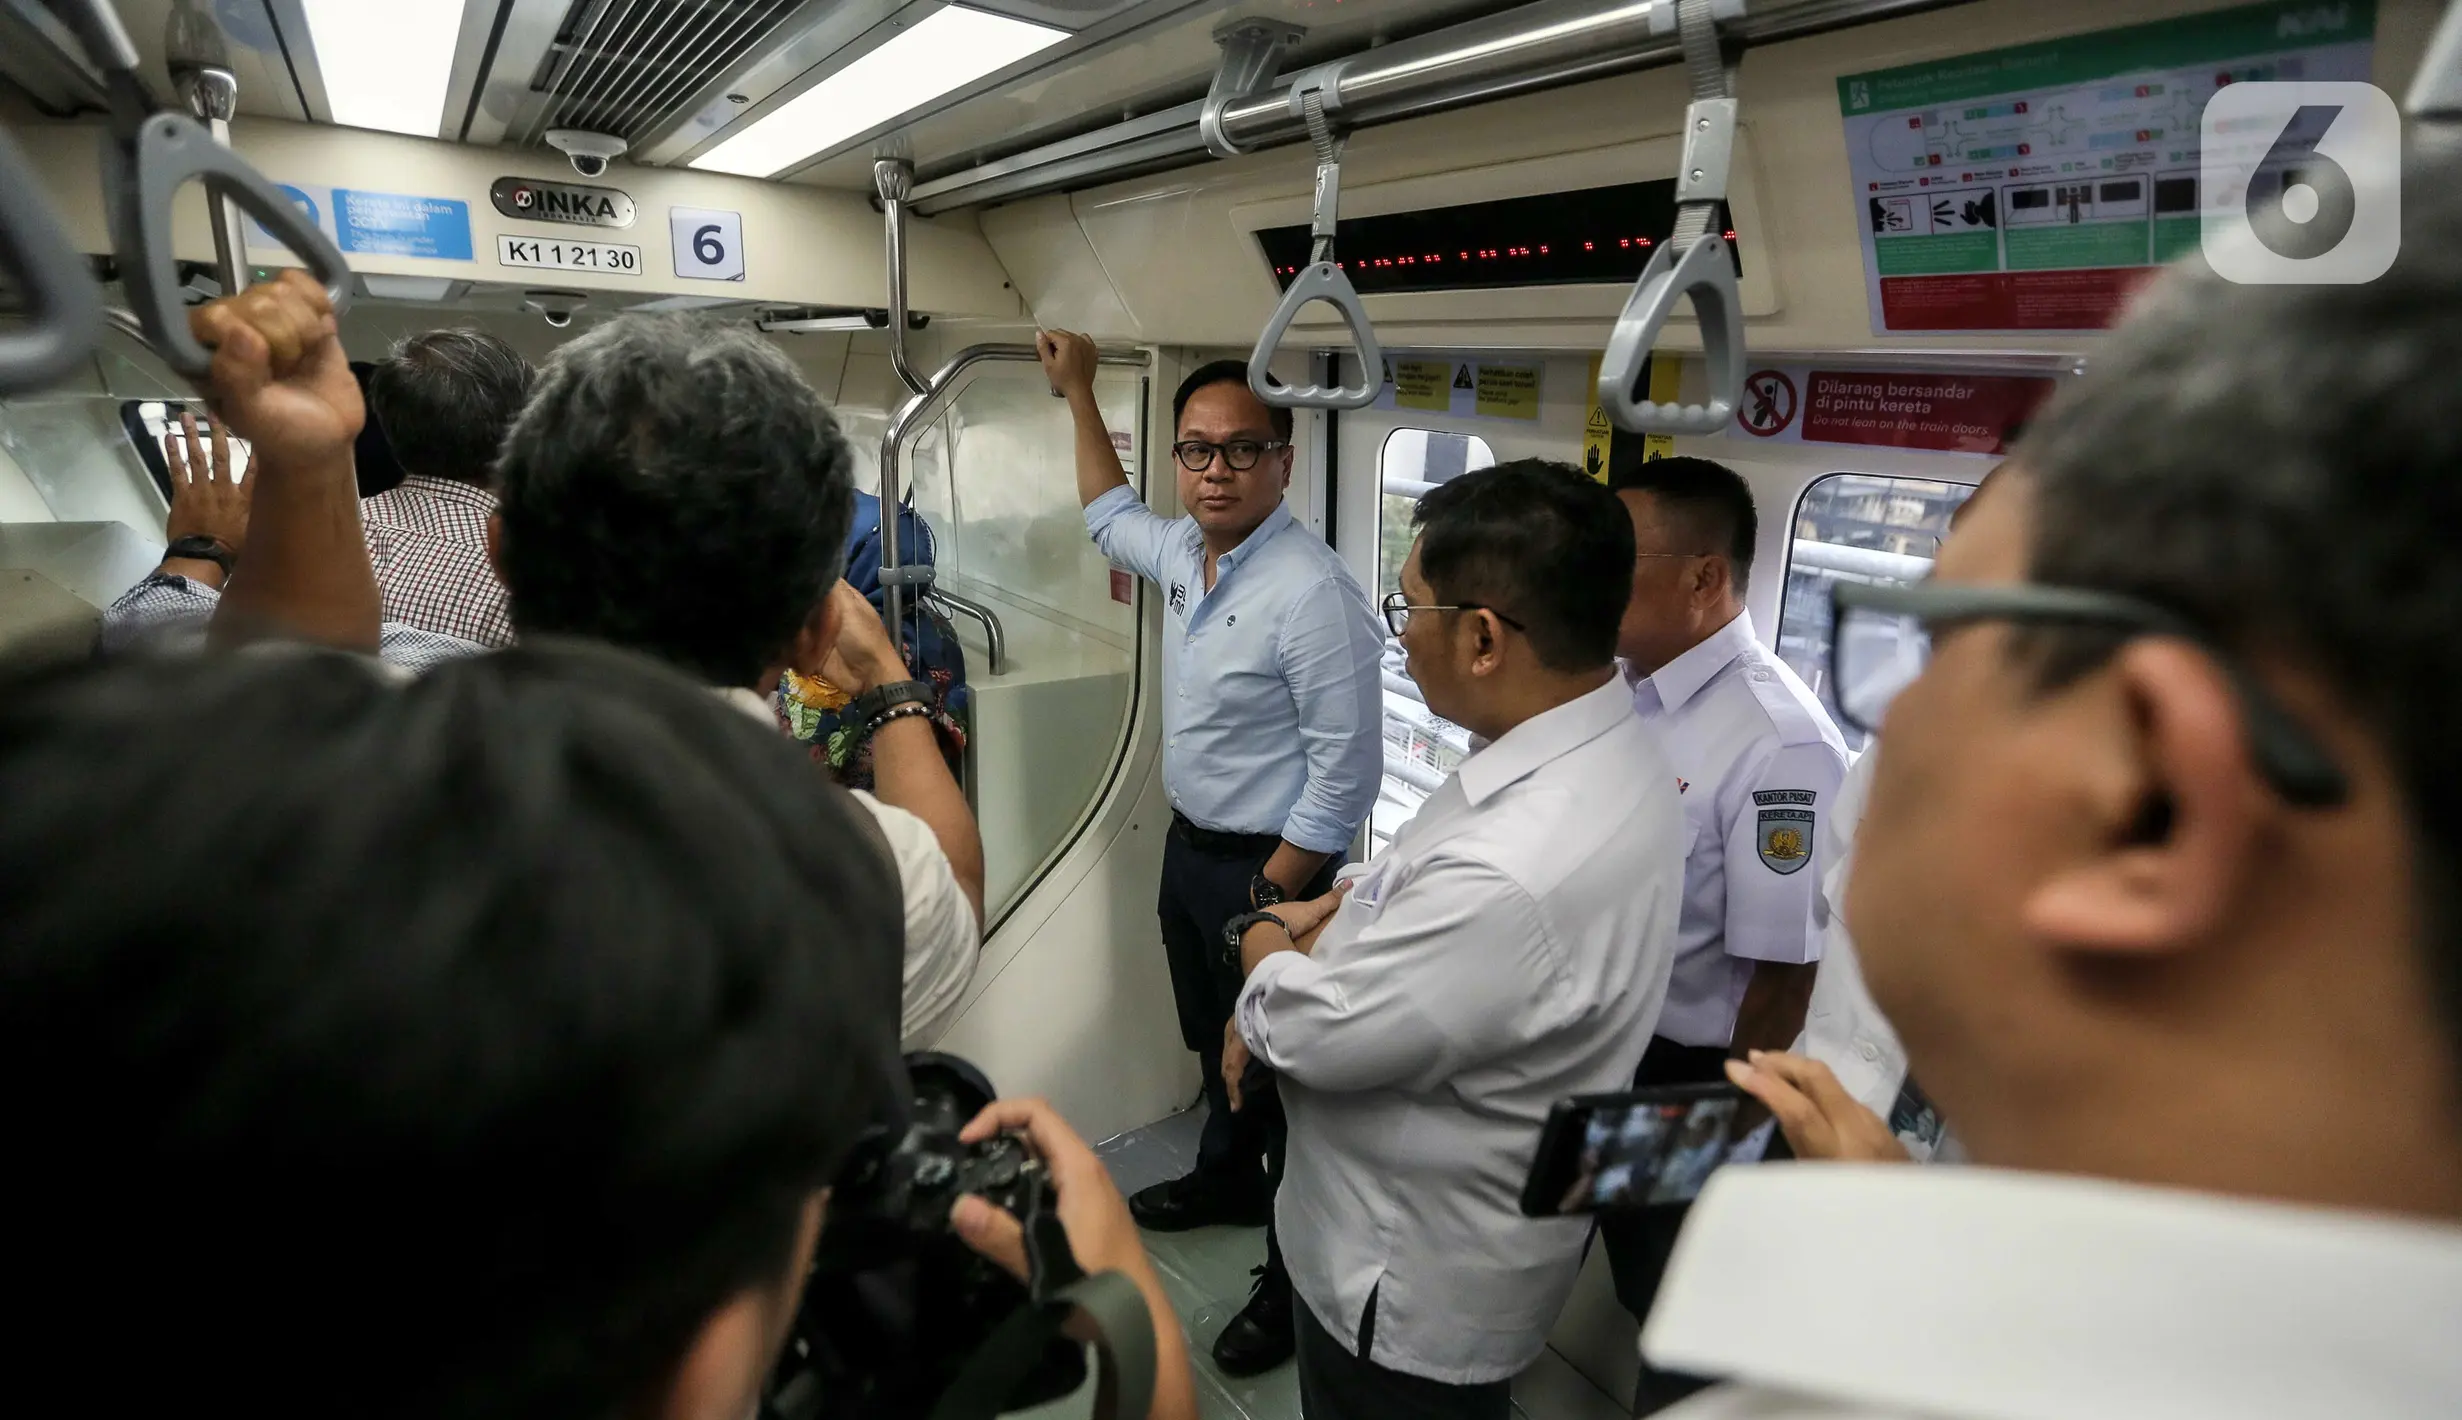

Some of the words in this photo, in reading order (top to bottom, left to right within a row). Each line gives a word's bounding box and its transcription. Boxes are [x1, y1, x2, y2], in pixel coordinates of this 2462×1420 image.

[414, 199, 454, 216] dalam
[535, 188, 618, 219] INKA
[693, 224, 725, 265] 6
[508, 241, 541, 262] K1
[551, 245, 563, 263] 1
[571, 247, 597, 266] 21
[607, 250, 634, 269] 30
[1817, 380, 1883, 399] Dilarang
[1888, 383, 1975, 400] bersandar
[1816, 395, 1831, 409] di
[1833, 397, 1875, 413] pintu
[1879, 397, 1932, 414] kereta
[1812, 414, 1829, 426] Do
[1831, 416, 1849, 427] not
[1851, 417, 1877, 429] lean
[1879, 421, 1894, 430] on
[1897, 419, 1917, 432] the
[1920, 421, 1949, 433] train
[1757, 793, 1788, 803] KANTOR
[1789, 792, 1812, 802] PUSAT
[1761, 812, 1794, 820] KERETA
